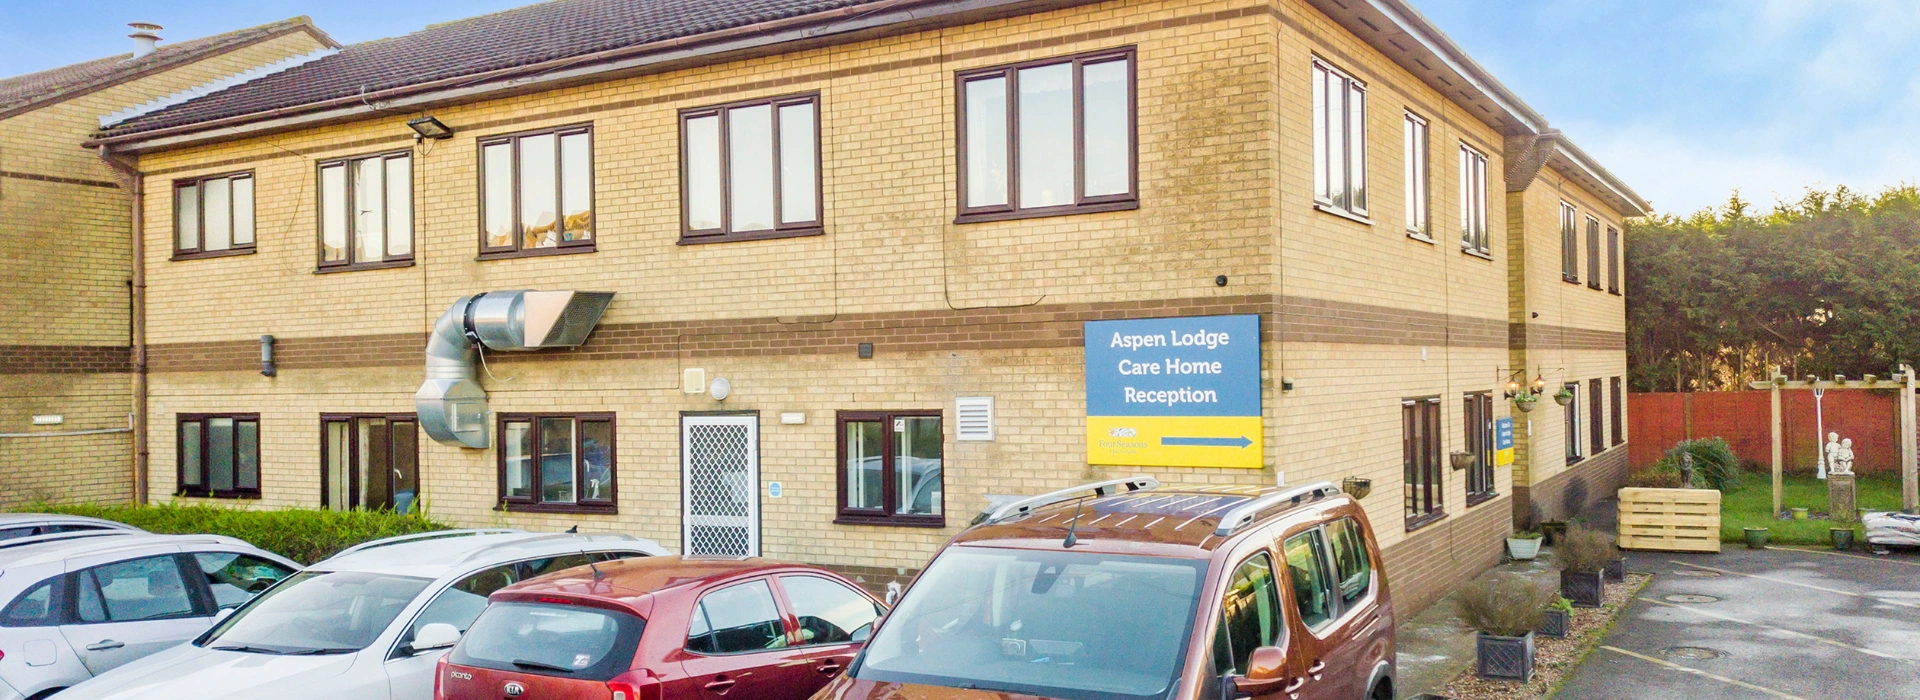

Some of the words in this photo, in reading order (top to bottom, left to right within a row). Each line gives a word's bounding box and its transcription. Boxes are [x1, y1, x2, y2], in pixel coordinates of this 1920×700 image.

[1110, 332, 1166, 351] Aspen
[1171, 330, 1229, 349] Lodge
[1118, 359, 1160, 375] Care
[1165, 358, 1222, 374] Home
[1124, 387, 1217, 406] Reception
[1099, 440, 1115, 448] Four
[1116, 440, 1148, 448] Seasons
[451, 671, 472, 680] picanto
[506, 684, 520, 695] KIA
